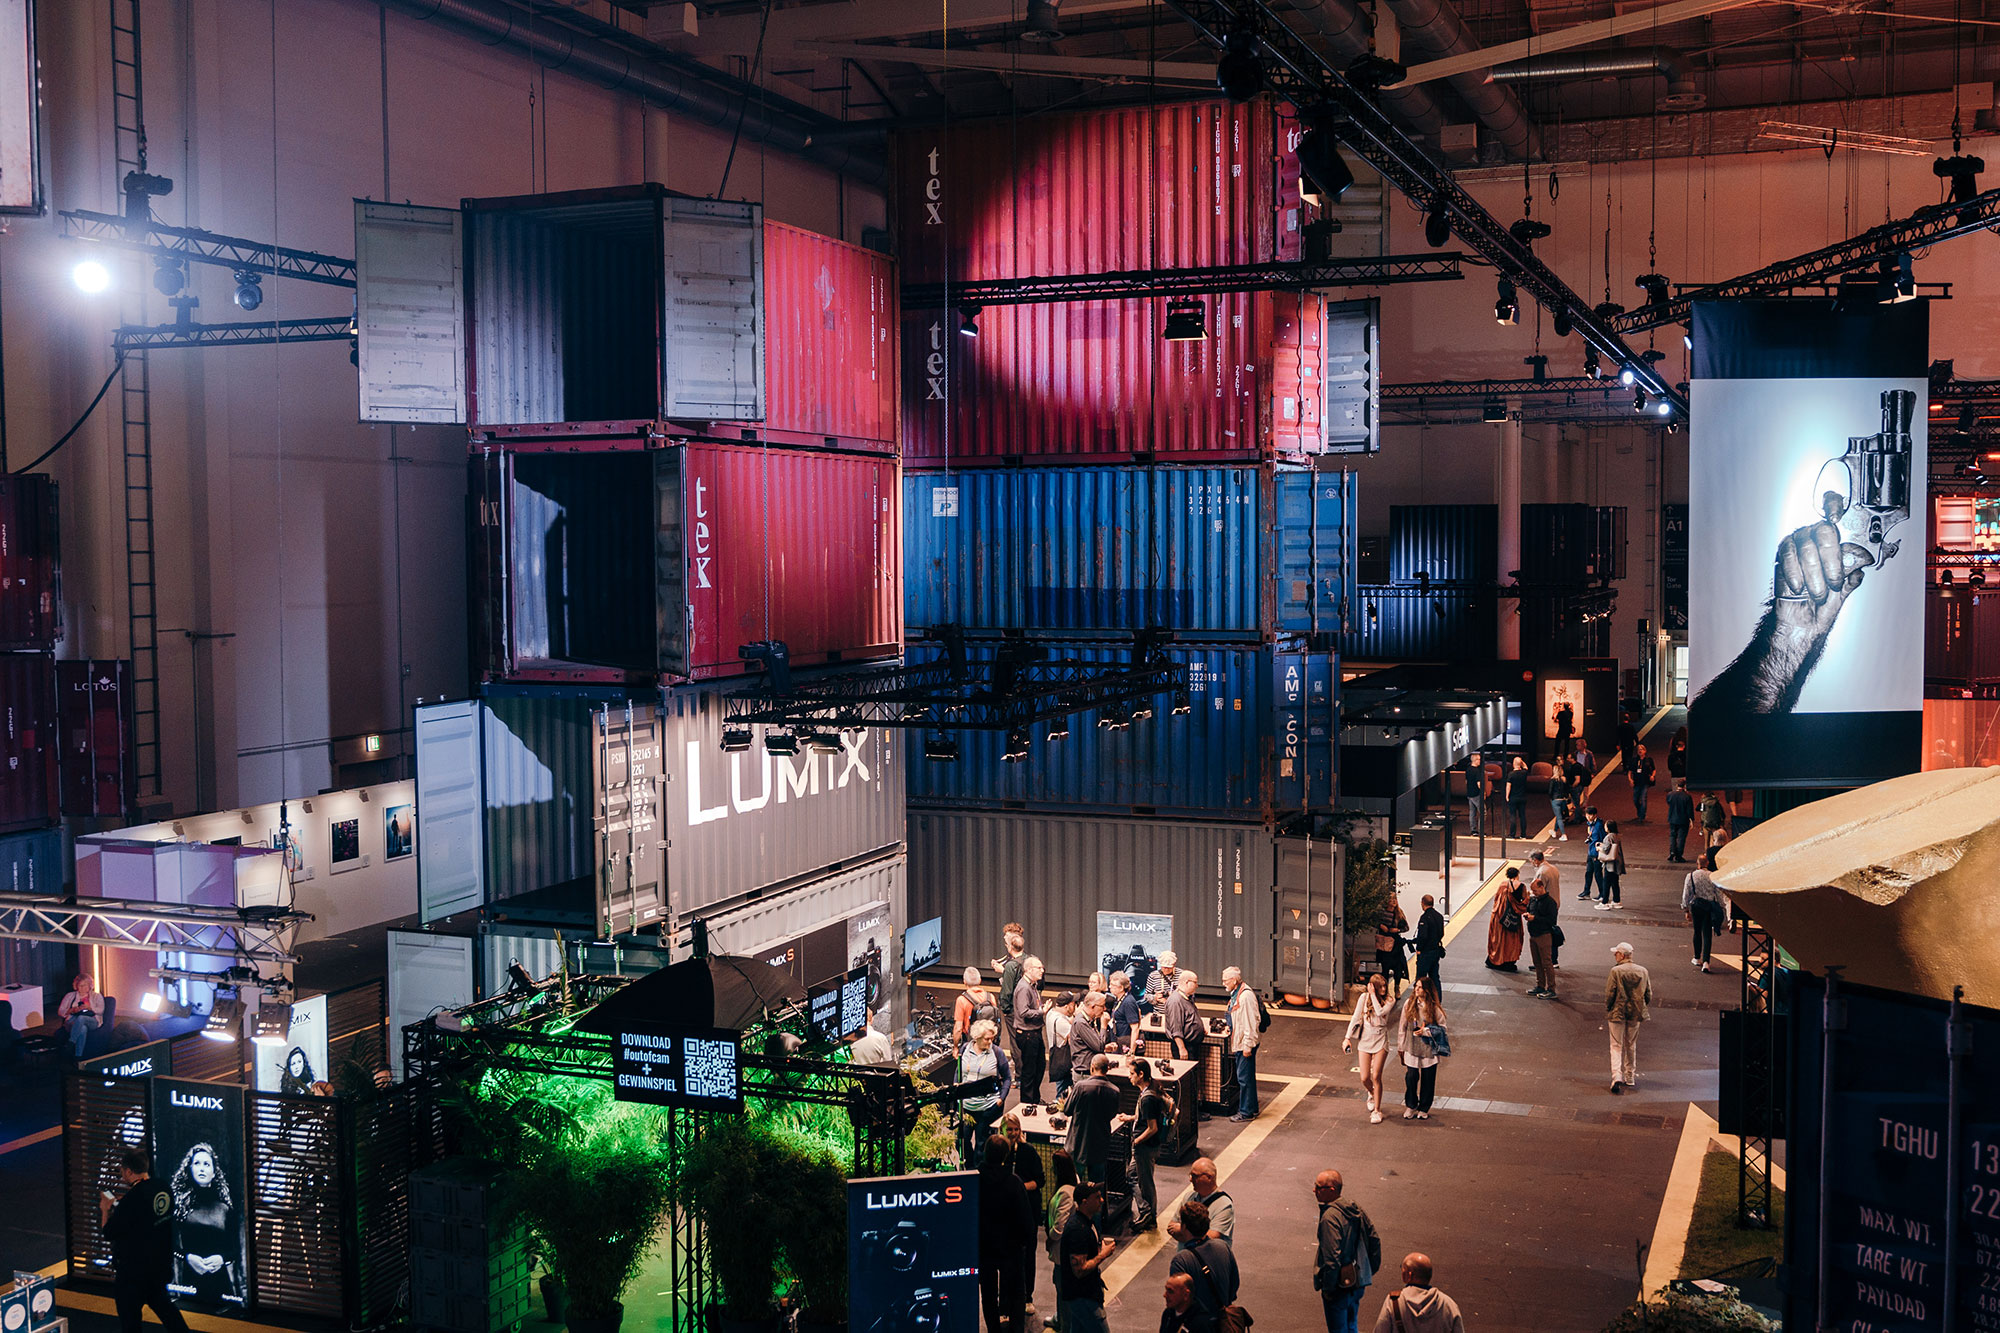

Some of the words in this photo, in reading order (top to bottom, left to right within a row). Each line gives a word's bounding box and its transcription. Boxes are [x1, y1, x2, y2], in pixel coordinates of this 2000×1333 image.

[925, 146, 945, 225] tex
[925, 320, 945, 400] tex
[695, 477, 712, 589] tex
[1666, 520, 1683, 532] A1
[74, 682, 117, 692] LOTUS
[687, 727, 871, 826] LUMIX
[858, 915, 880, 933] LUMIX
[1113, 919, 1156, 932] LUMIX
[787, 948, 795, 962] S
[811, 990, 838, 1010] DOWNLOAD
[621, 1033, 671, 1050] DOWNLOAD
[623, 1047, 670, 1065] #outofcam
[618, 1073, 678, 1093] GEWINNSPIEL
[170, 1089, 224, 1111] LUMIX
[1879, 1117, 1938, 1160] TGHU
[866, 1190, 940, 1210] LUMIX
[944, 1185, 963, 1204] S
[1859, 1205, 1901, 1237] MAX.
[1904, 1218, 1937, 1247] WT.
[931, 1270, 958, 1278] LUMIX
[1856, 1243, 1892, 1275] TARE
[1899, 1256, 1930, 1288] WT.
[1856, 1281, 1926, 1321] PAYLOAD
